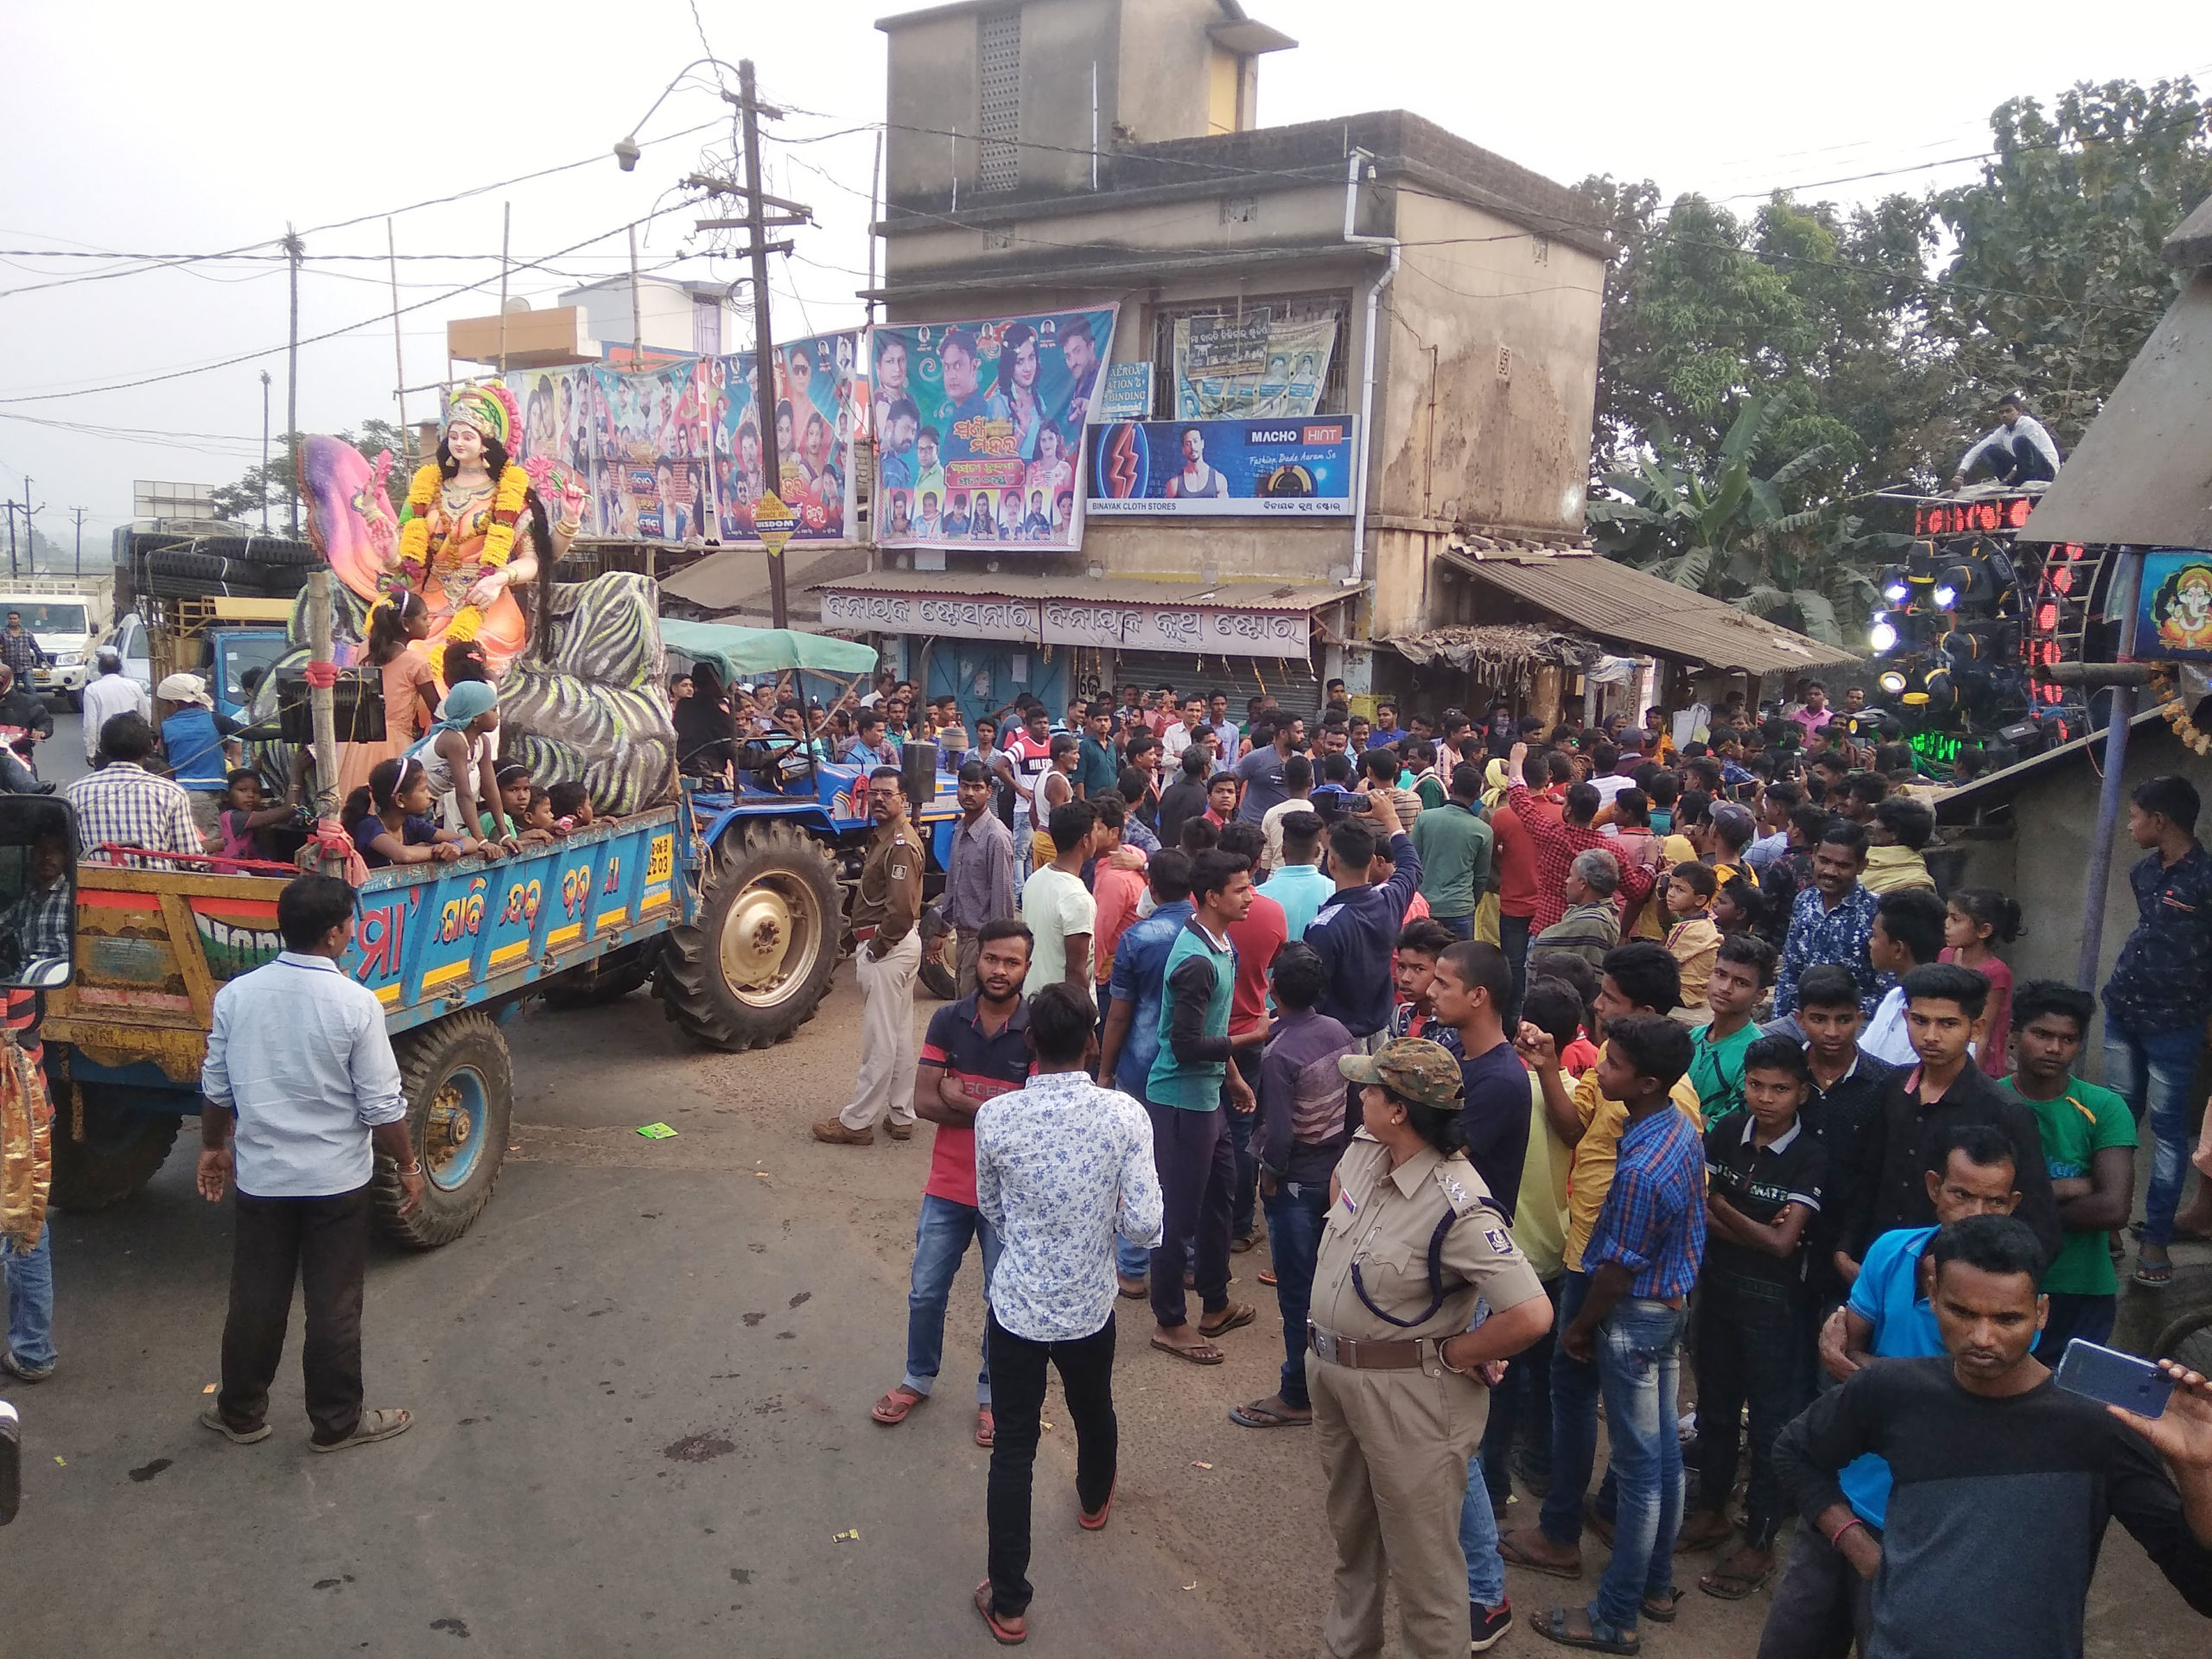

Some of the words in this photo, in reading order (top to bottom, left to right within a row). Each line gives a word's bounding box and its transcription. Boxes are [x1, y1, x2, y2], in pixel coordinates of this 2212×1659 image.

[1109, 391, 1147, 402] BINDING
[1251, 430, 1297, 442] MACHO
[1249, 455, 1276, 466] Fashion
[1300, 451, 1324, 461] Aaram
[1326, 448, 1337, 459] Se
[1092, 502, 1122, 511] BINAYAK
[823, 589, 910, 623] ବିନାୟକ
[1044, 601, 1143, 635] ବିନାୟକ
